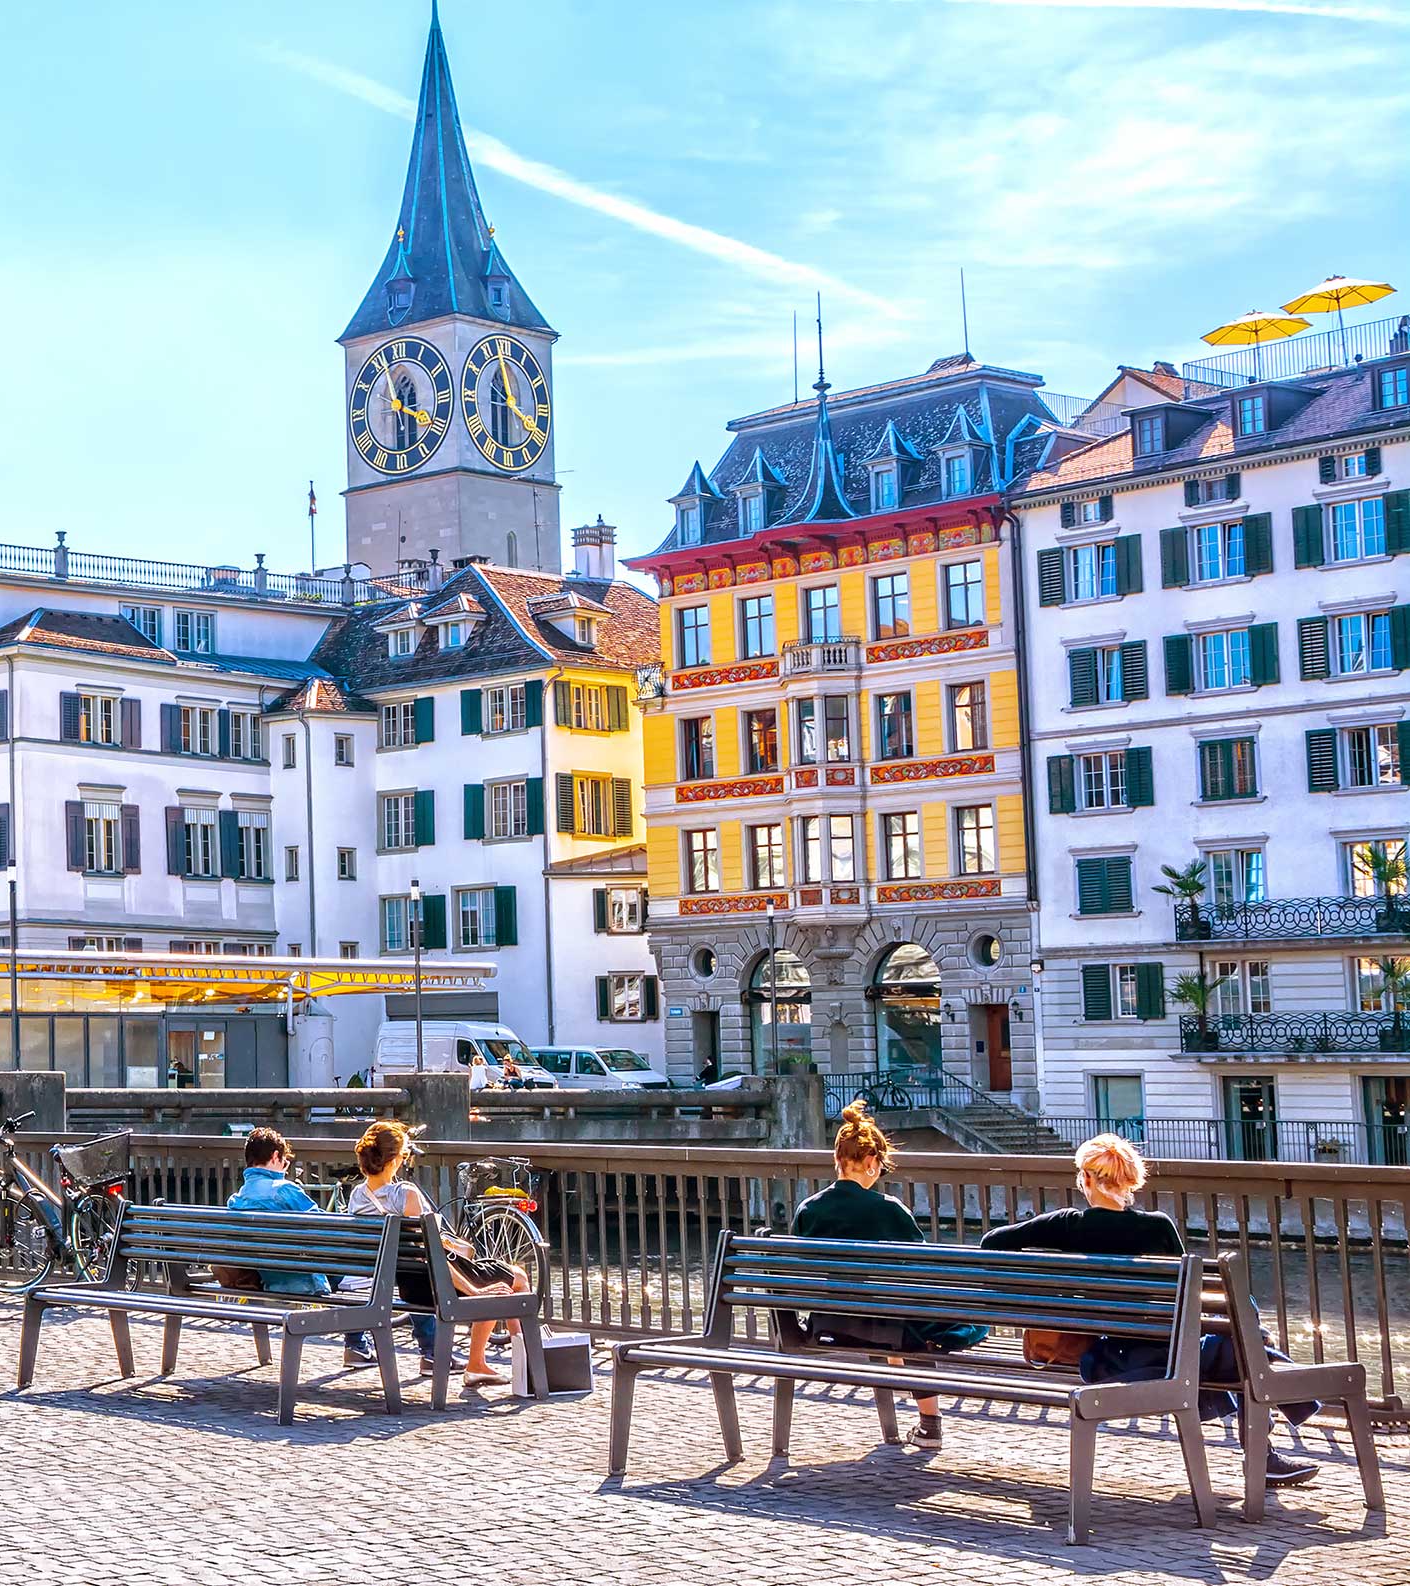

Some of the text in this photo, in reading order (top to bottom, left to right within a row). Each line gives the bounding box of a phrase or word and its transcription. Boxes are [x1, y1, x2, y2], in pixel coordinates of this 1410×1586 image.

[392, 342, 406, 360] XII
[418, 345, 425, 360] I
[480, 343, 493, 360] XI
[520, 352, 527, 366] I
[431, 362, 444, 378] II
[469, 361, 480, 375] X
[358, 380, 370, 392] X
[532, 375, 543, 389] II
[437, 389, 450, 403] III
[463, 388, 475, 402] IX
[352, 408, 365, 422] IX
[537, 404, 548, 417] III
